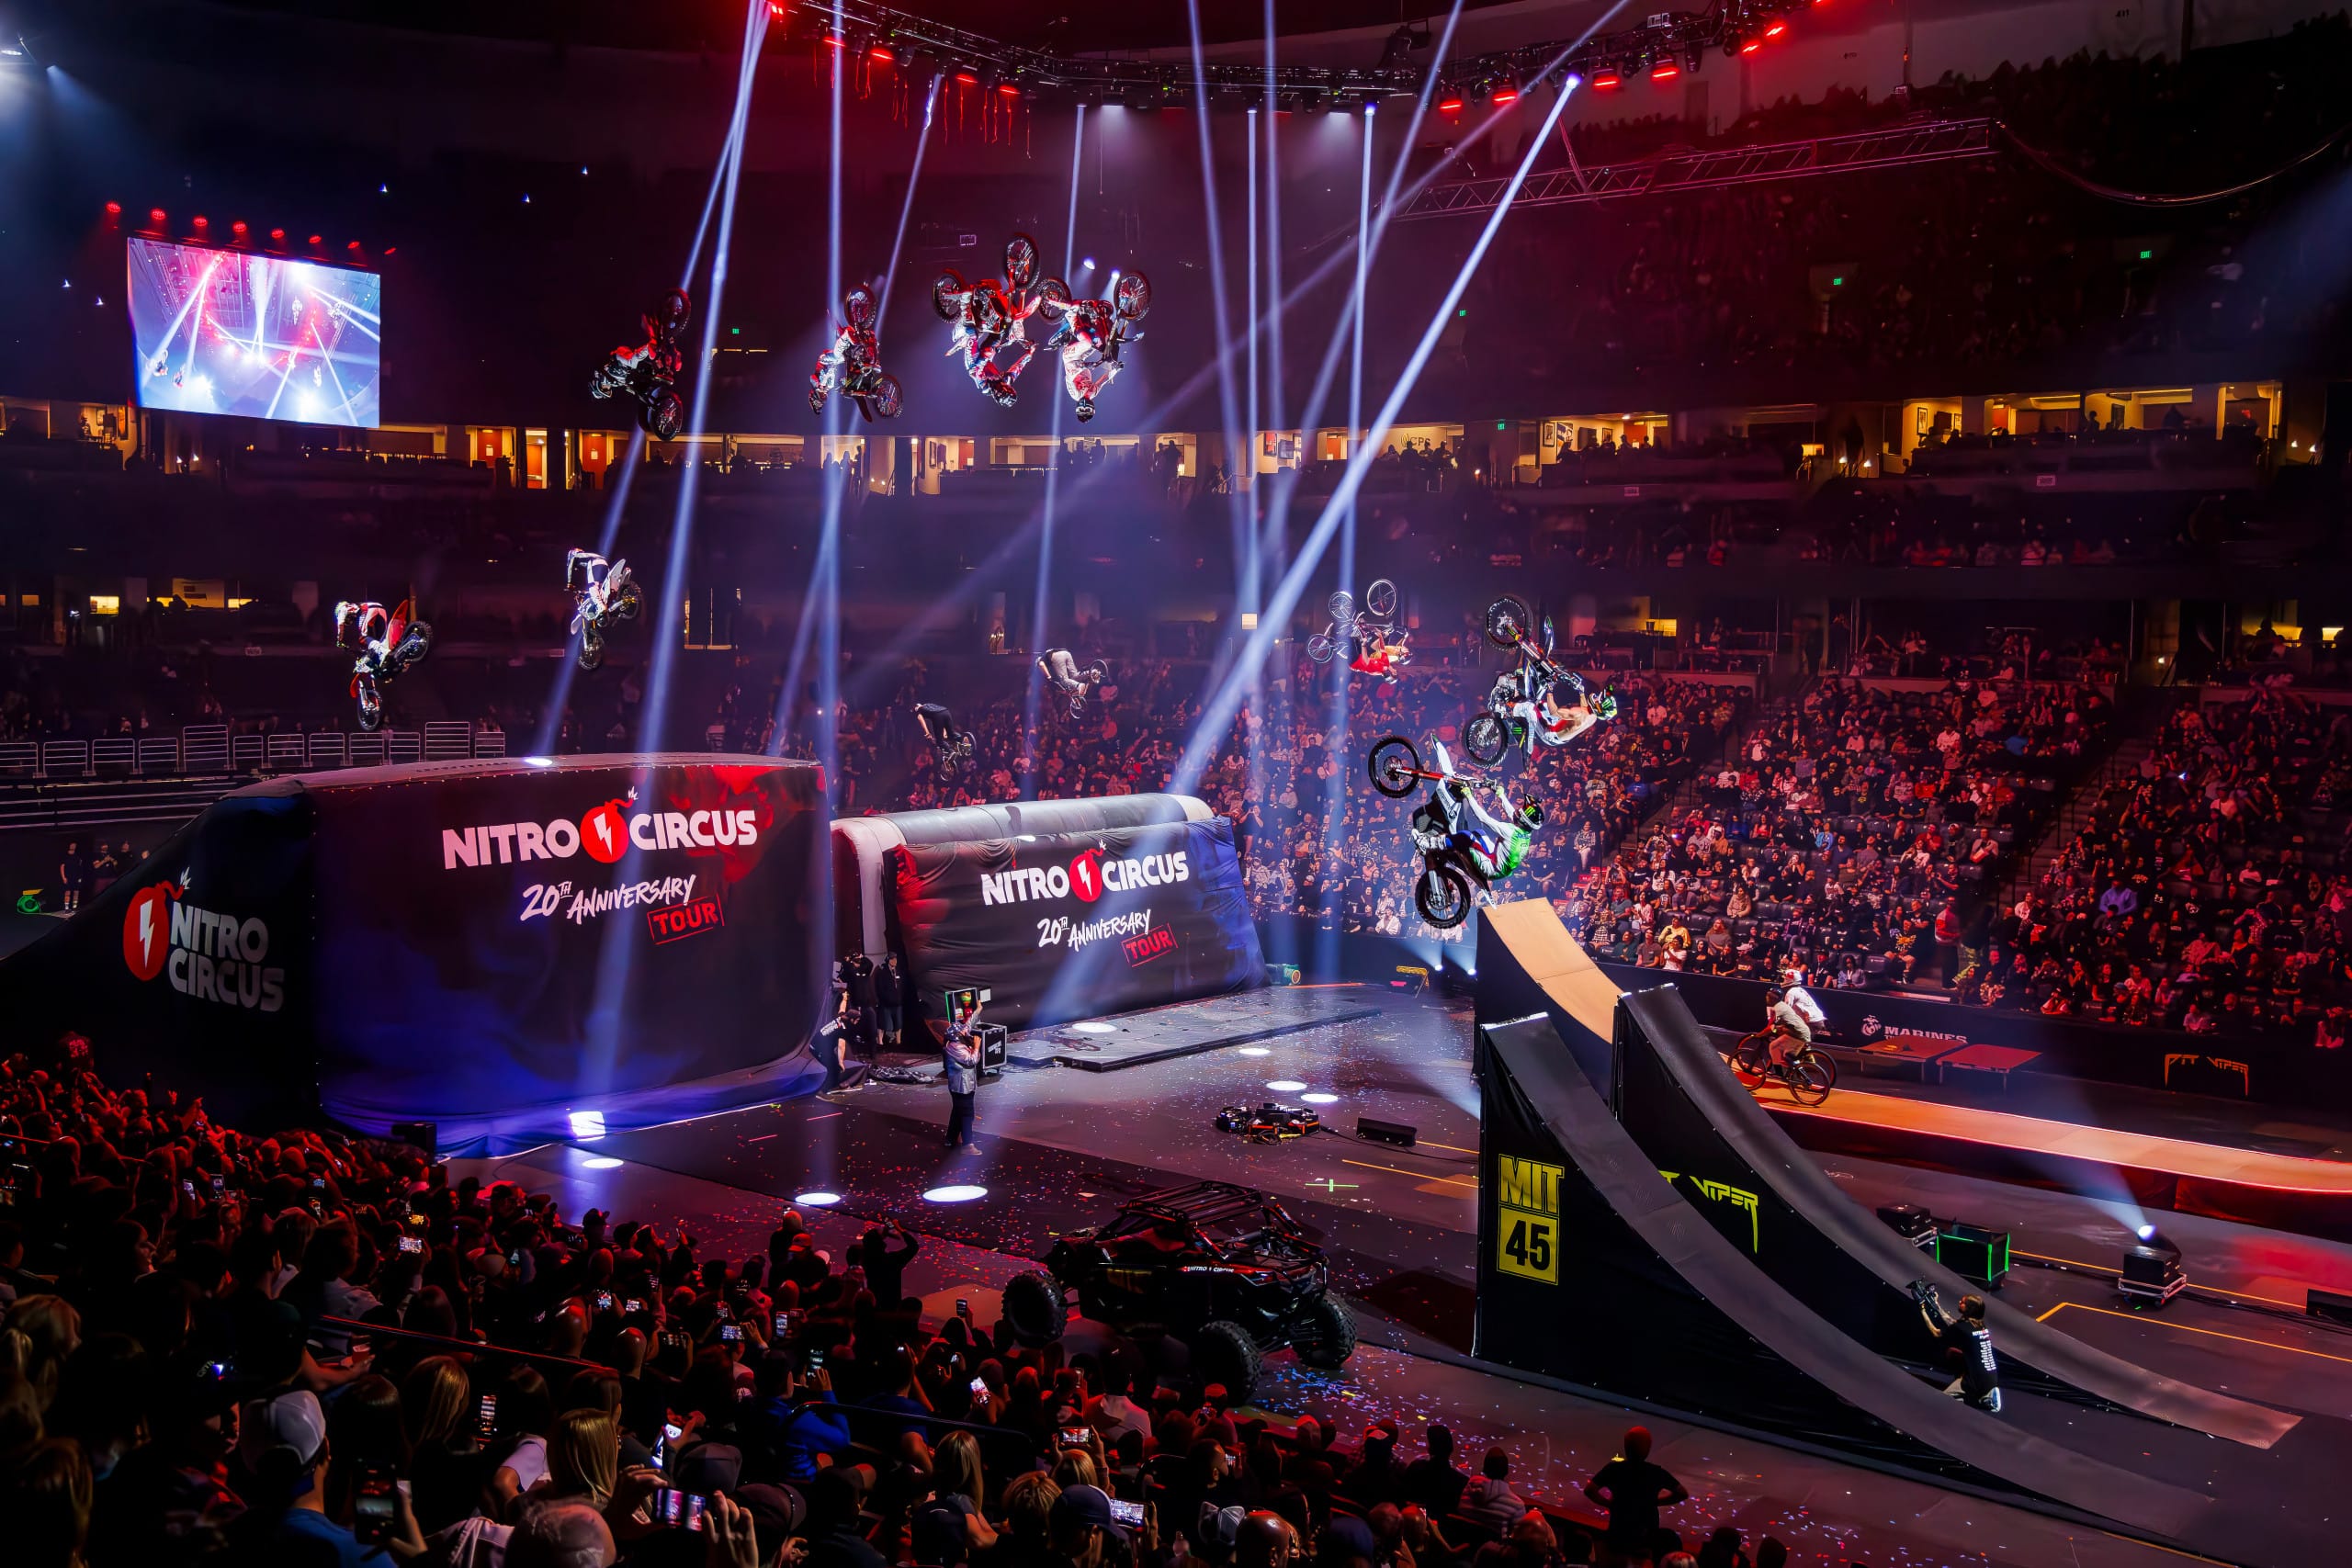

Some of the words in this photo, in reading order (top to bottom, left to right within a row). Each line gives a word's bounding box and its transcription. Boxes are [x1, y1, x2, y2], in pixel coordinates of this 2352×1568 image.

[441, 818, 580, 870] NITRO
[628, 809, 758, 851] CIRCUS
[567, 874, 696, 925] ANNIVERSARY
[980, 866, 1070, 906] NITRO
[1102, 851, 1189, 892] CIRCUS
[170, 901, 269, 964] NITRO
[652, 903, 719, 935] TOUR
[1068, 908, 1151, 952] ANNIVERSARY
[1125, 931, 1172, 961] TOUR
[168, 948, 285, 1012] CIRCUS
[2165, 1054, 2199, 1088] PIT
[2206, 1056, 2248, 1096] VIPER
[1498, 1156, 1565, 1213] MIT
[1690, 1176, 1758, 1255] VIPER
[1505, 1219, 1551, 1270] 45
